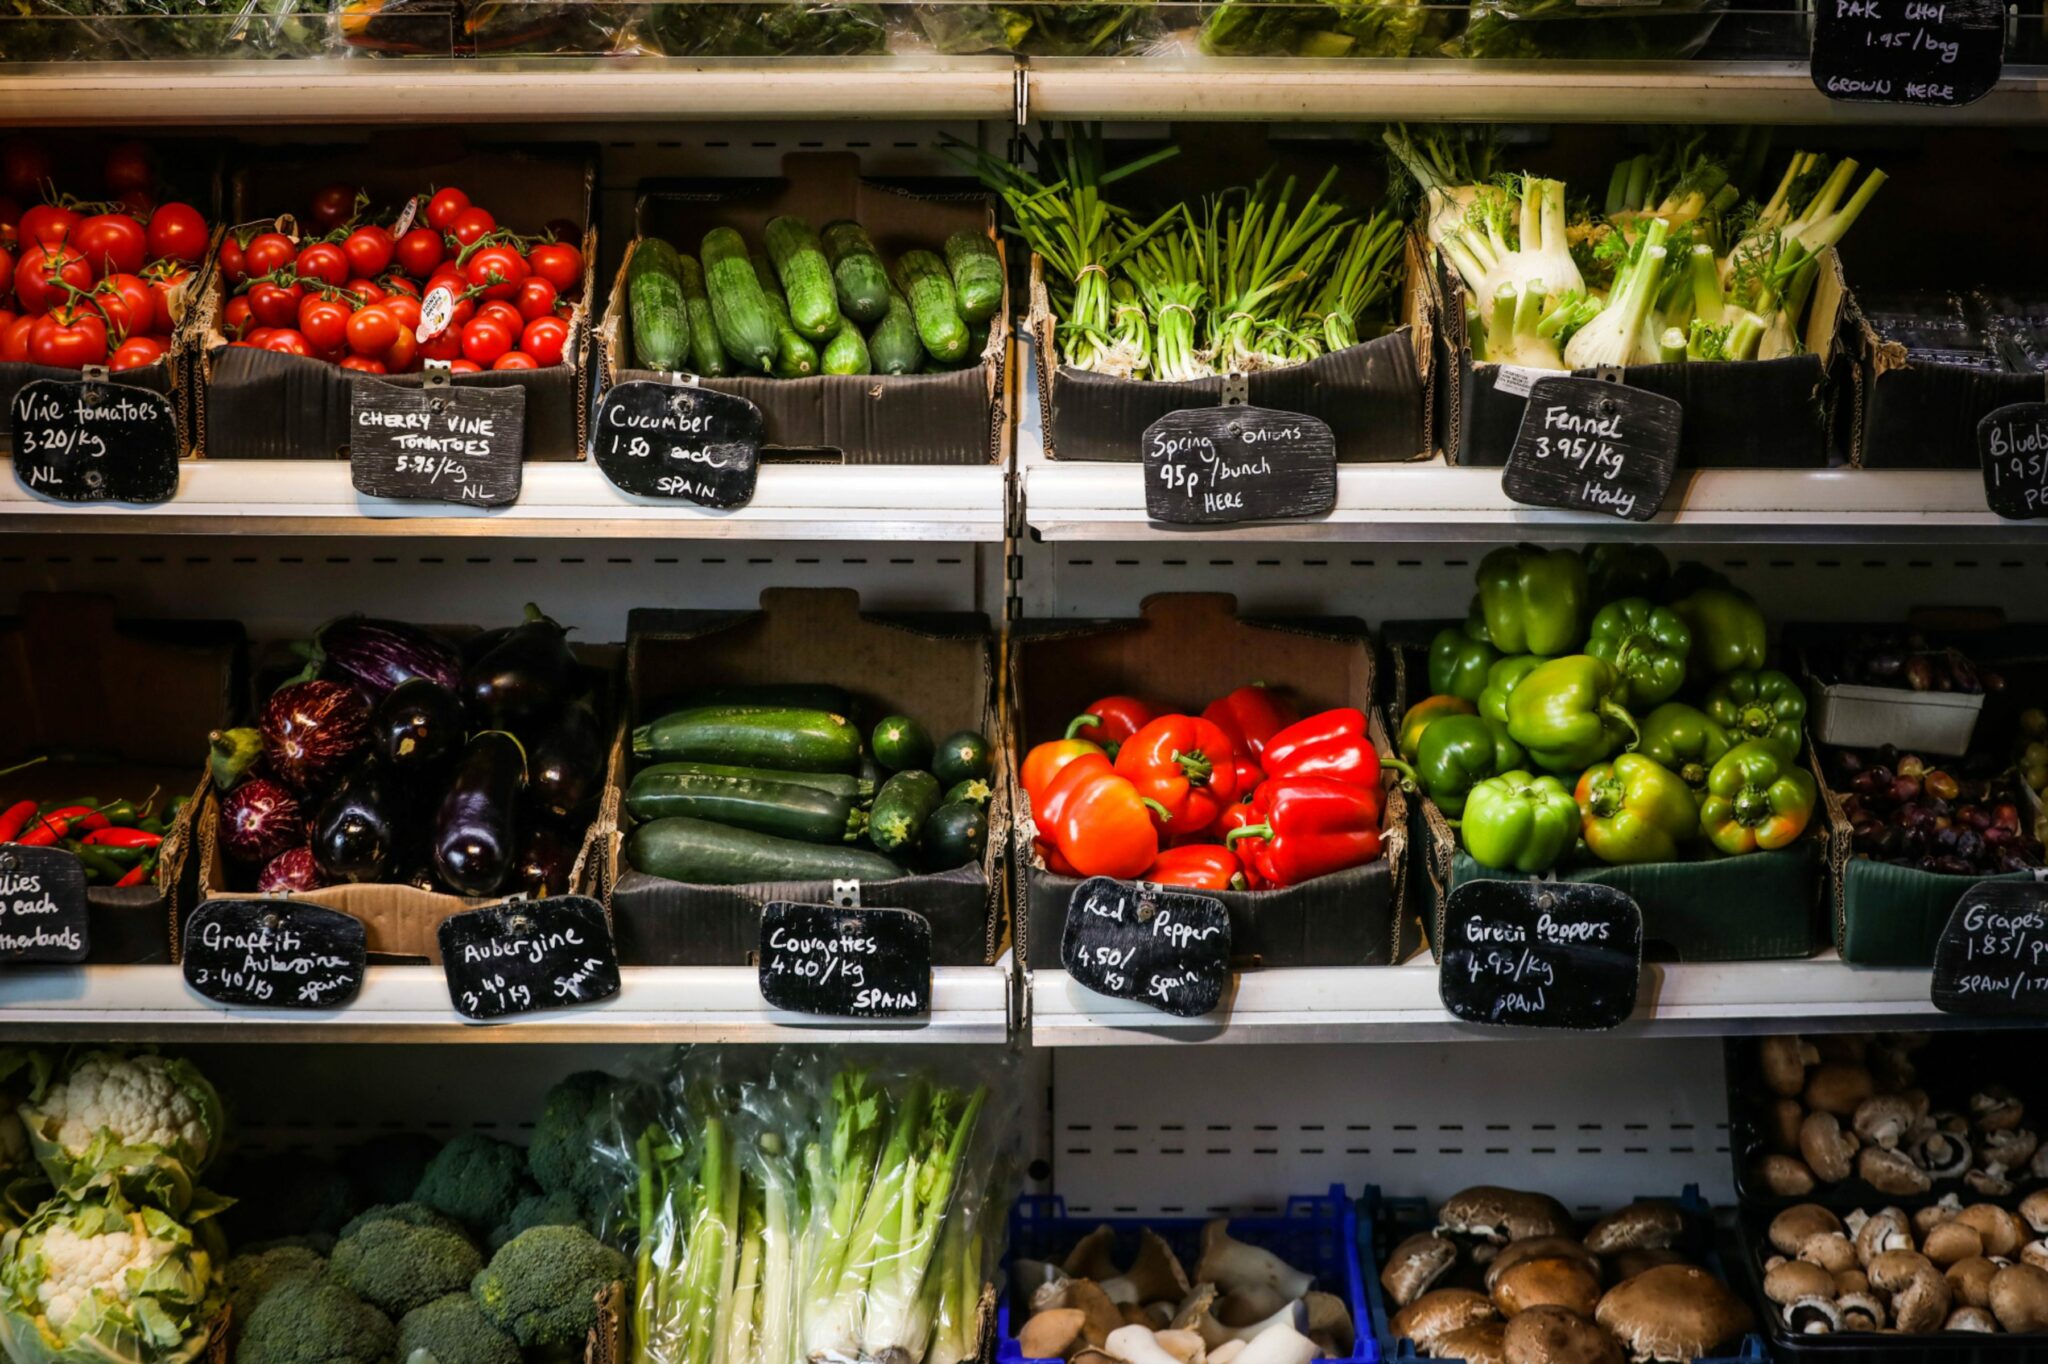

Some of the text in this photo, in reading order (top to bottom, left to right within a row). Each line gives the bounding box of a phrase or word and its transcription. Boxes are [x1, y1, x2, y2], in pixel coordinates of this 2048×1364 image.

[1836, 0, 1881, 19] PAK
[1866, 27, 1959, 63] 1.95/bag
[1827, 75, 1954, 100] GROWN HERE
[20, 391, 158, 424] Vine tomatoes
[609, 404, 713, 433] Cucumber
[1544, 405, 1623, 439] Fennel
[359, 411, 495, 437] CHERRY VINE
[390, 433, 490, 456] TOMATOES
[611, 435, 650, 457] 1.50
[1151, 430, 1217, 463] Spring
[30, 466, 62, 486] NL
[657, 476, 716, 498] SPAIN
[461, 484, 495, 499] NL
[1204, 492, 1244, 514] HERE
[1582, 480, 1636, 516] Italy
[13, 892, 59, 915] each
[1083, 897, 1220, 949] Red Pepper
[1466, 914, 1611, 945] Green Peppers
[1963, 904, 2045, 938] Grapes
[203, 922, 301, 954] Graffiti
[465, 928, 584, 963] Aubergine
[769, 927, 877, 961] Courgettes
[242, 951, 350, 974] Aubergine
[1148, 964, 1199, 1003] Spain
[852, 988, 917, 1009] SPAIN
